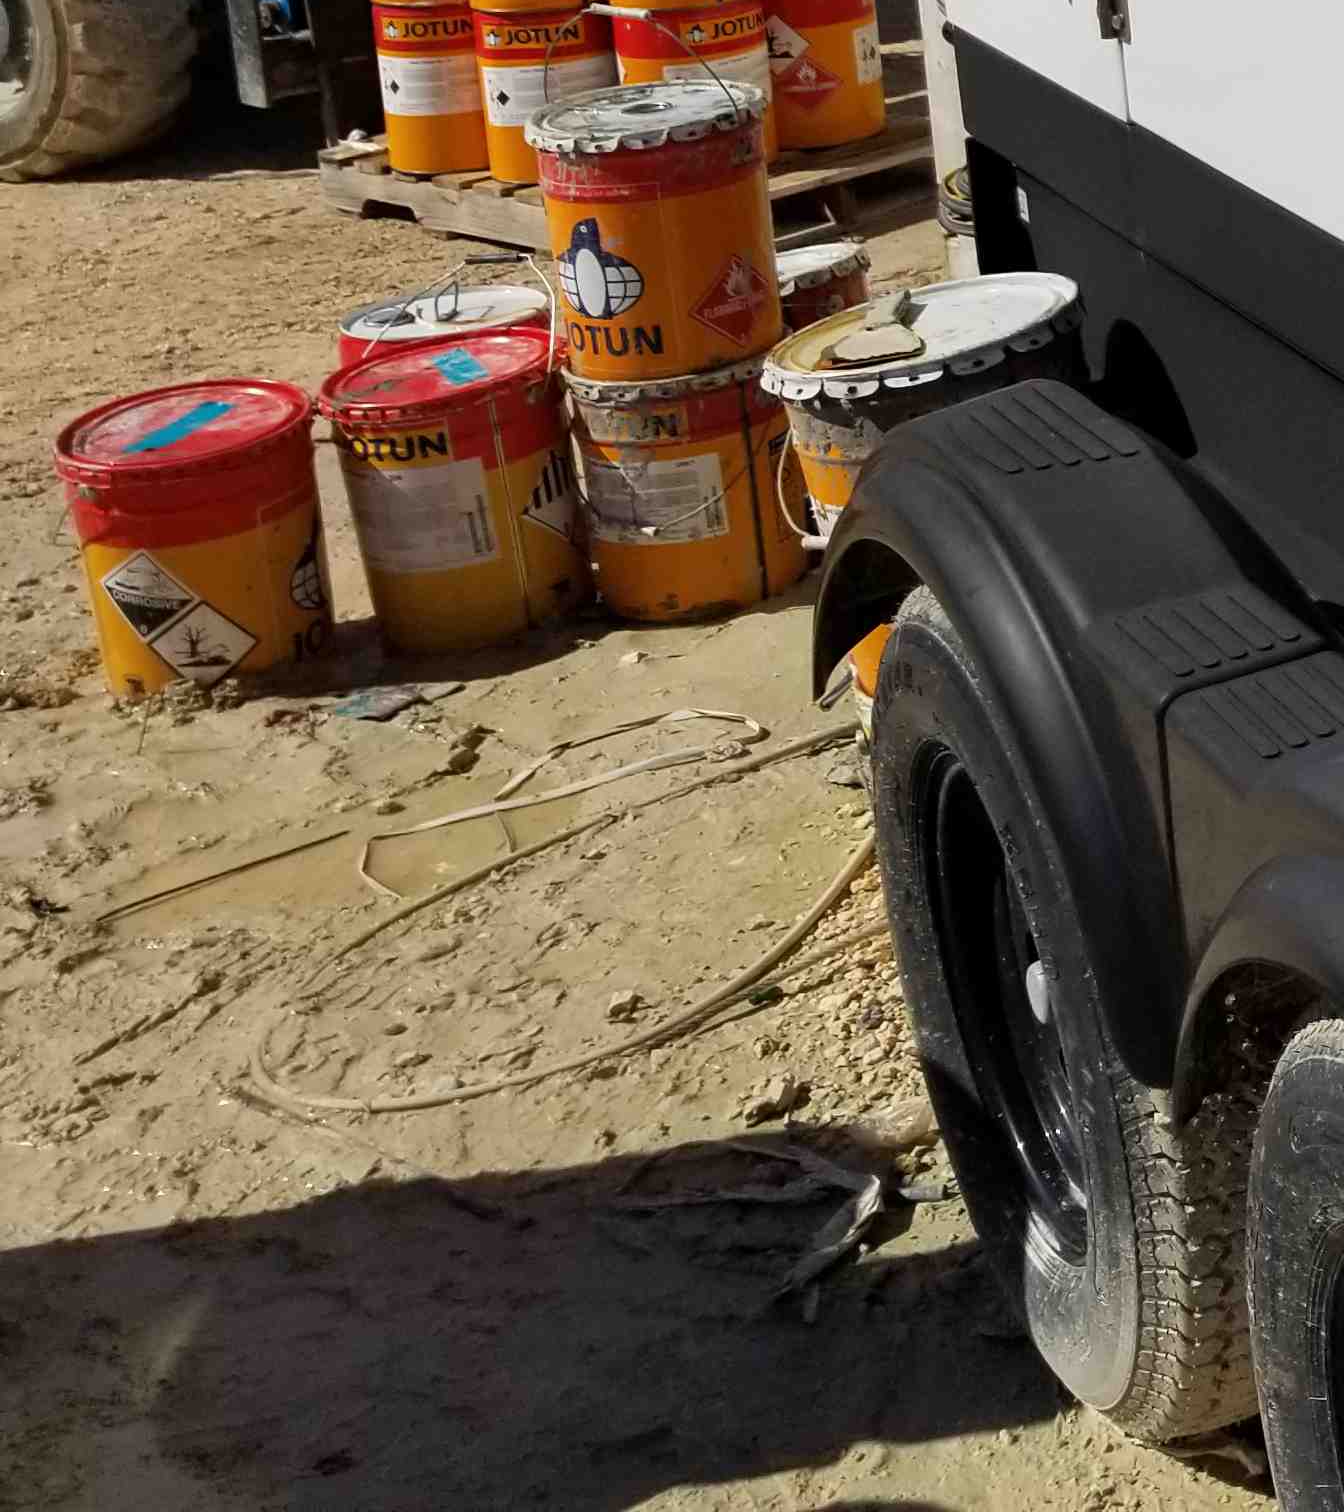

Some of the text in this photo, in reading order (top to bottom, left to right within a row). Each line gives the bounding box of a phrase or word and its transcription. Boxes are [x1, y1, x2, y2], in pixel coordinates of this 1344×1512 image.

[402, 19, 473, 39] JOTUN
[504, 23, 580, 46] JOTUN
[712, 14, 765, 39] JOTUN
[567, 322, 665, 358] OTUN
[350, 431, 449, 463] OTUN
